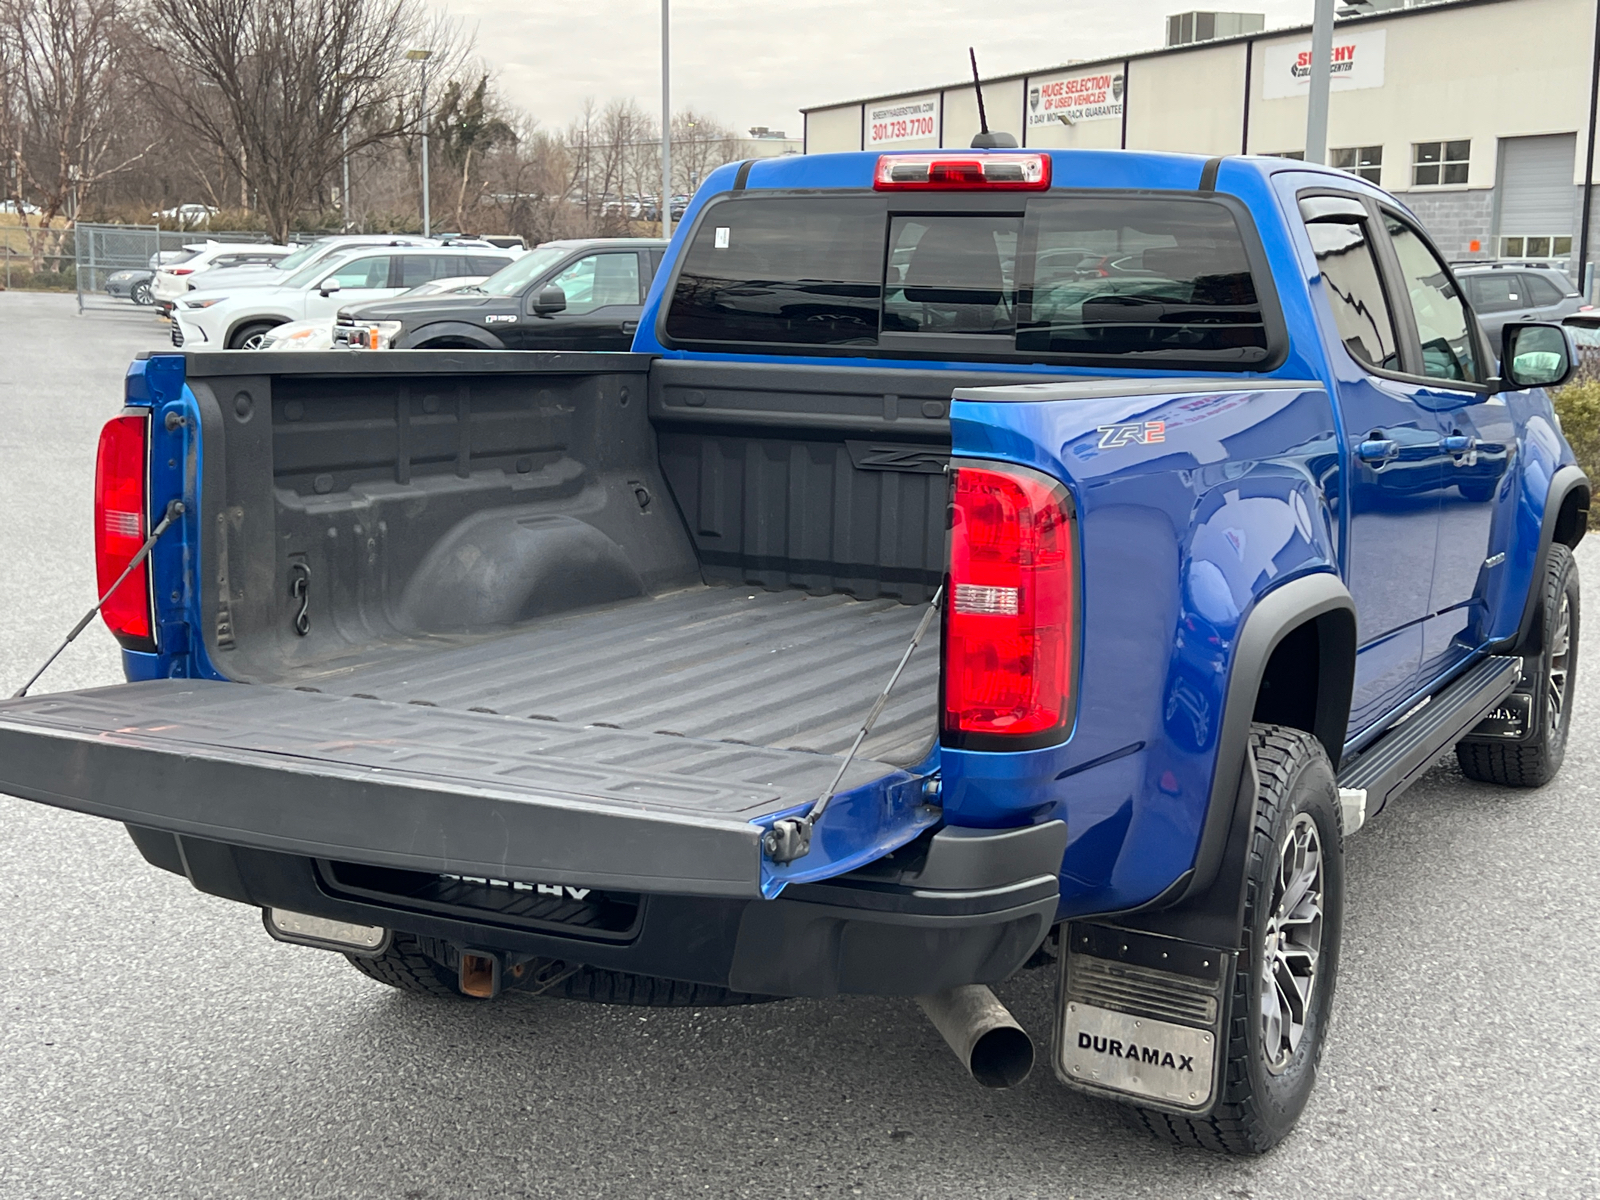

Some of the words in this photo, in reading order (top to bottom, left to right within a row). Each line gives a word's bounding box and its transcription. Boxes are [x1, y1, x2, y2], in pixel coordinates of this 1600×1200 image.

[1041, 82, 1064, 98] HUGE
[1065, 75, 1111, 94] SELECTION
[872, 102, 934, 120] SHEEHYHAGERSTOWN.COM
[1044, 98, 1054, 110] OF
[1055, 95, 1073, 109] USED
[1074, 91, 1106, 106] VEHICLES
[1034, 112, 1046, 124] DAY
[1085, 104, 1122, 118] GUARANTEE
[872, 116, 933, 141] 301.739.7700
[1097, 420, 1165, 449] ZR2
[1078, 1032, 1194, 1073] DURAMAX
